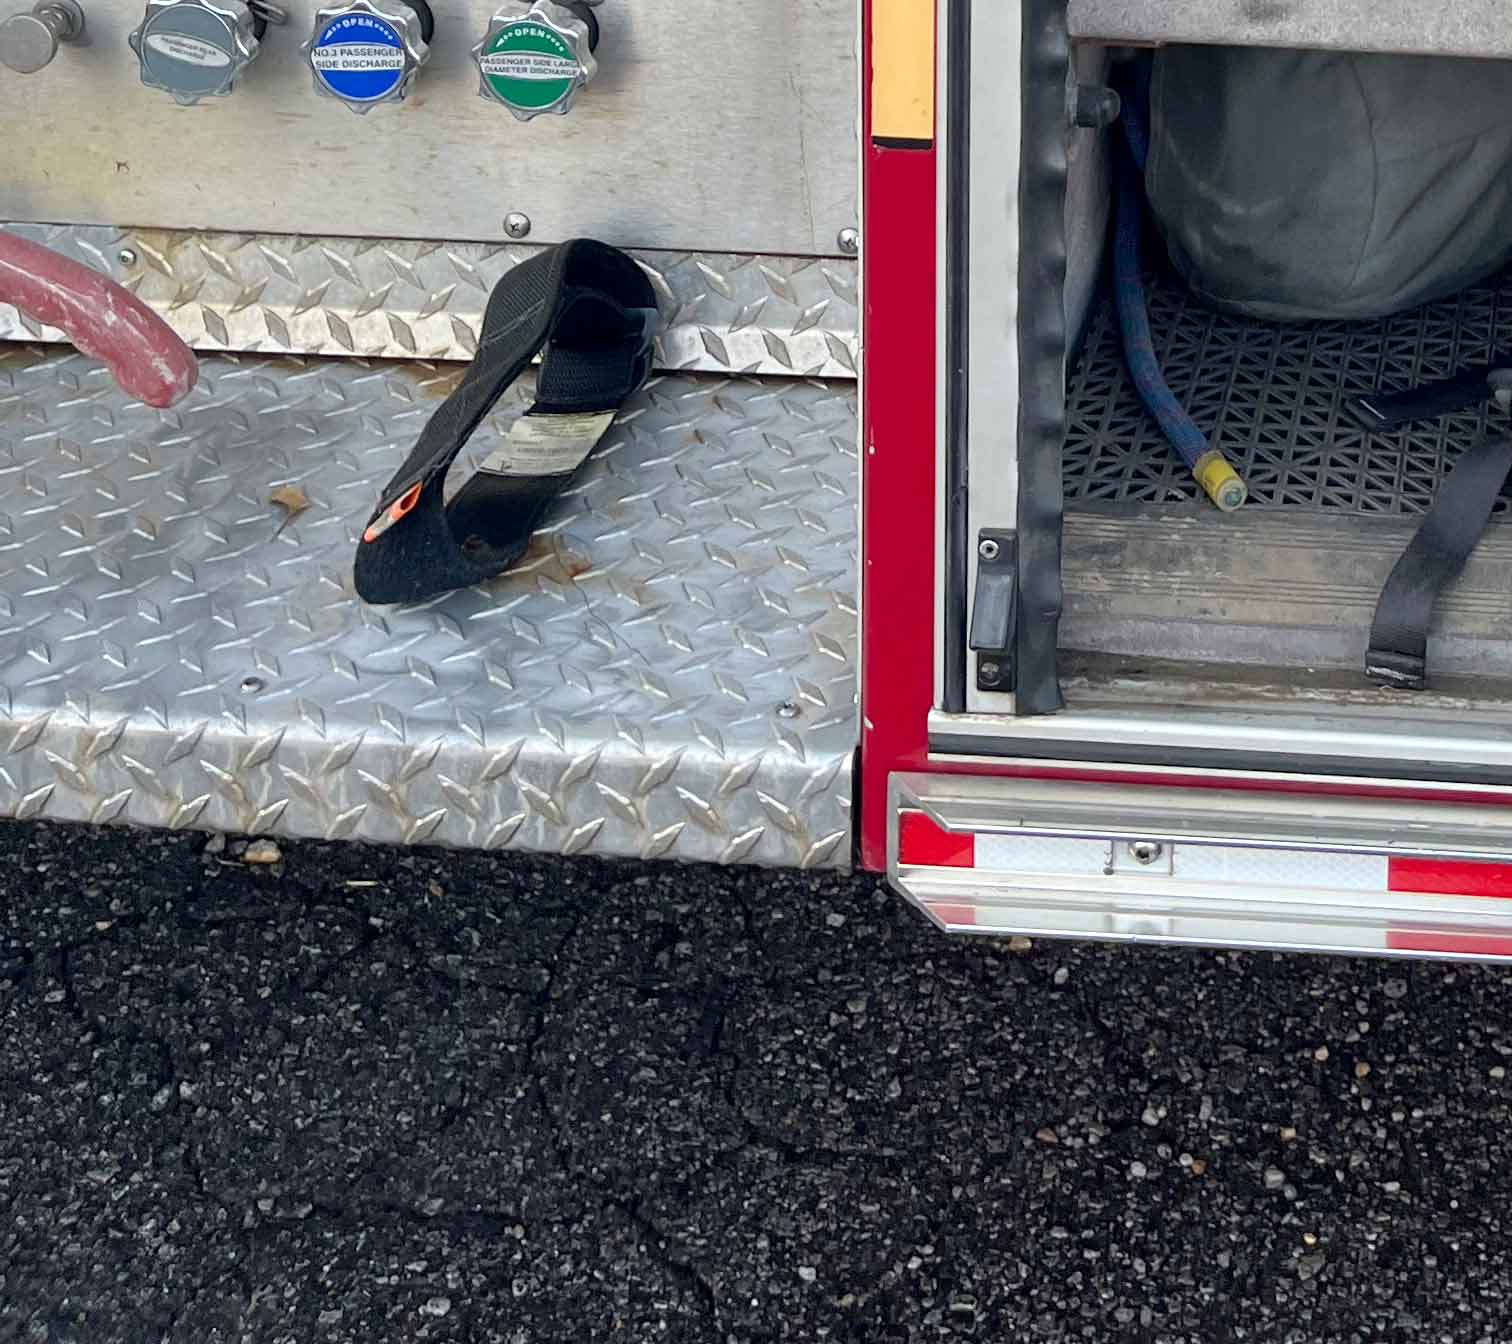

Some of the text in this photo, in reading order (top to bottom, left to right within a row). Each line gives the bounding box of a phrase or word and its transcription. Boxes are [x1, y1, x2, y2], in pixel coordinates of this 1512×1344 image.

[341, 17, 374, 29] OPEN
[514, 27, 546, 38] OPEN
[315, 59, 339, 69] SIDE
